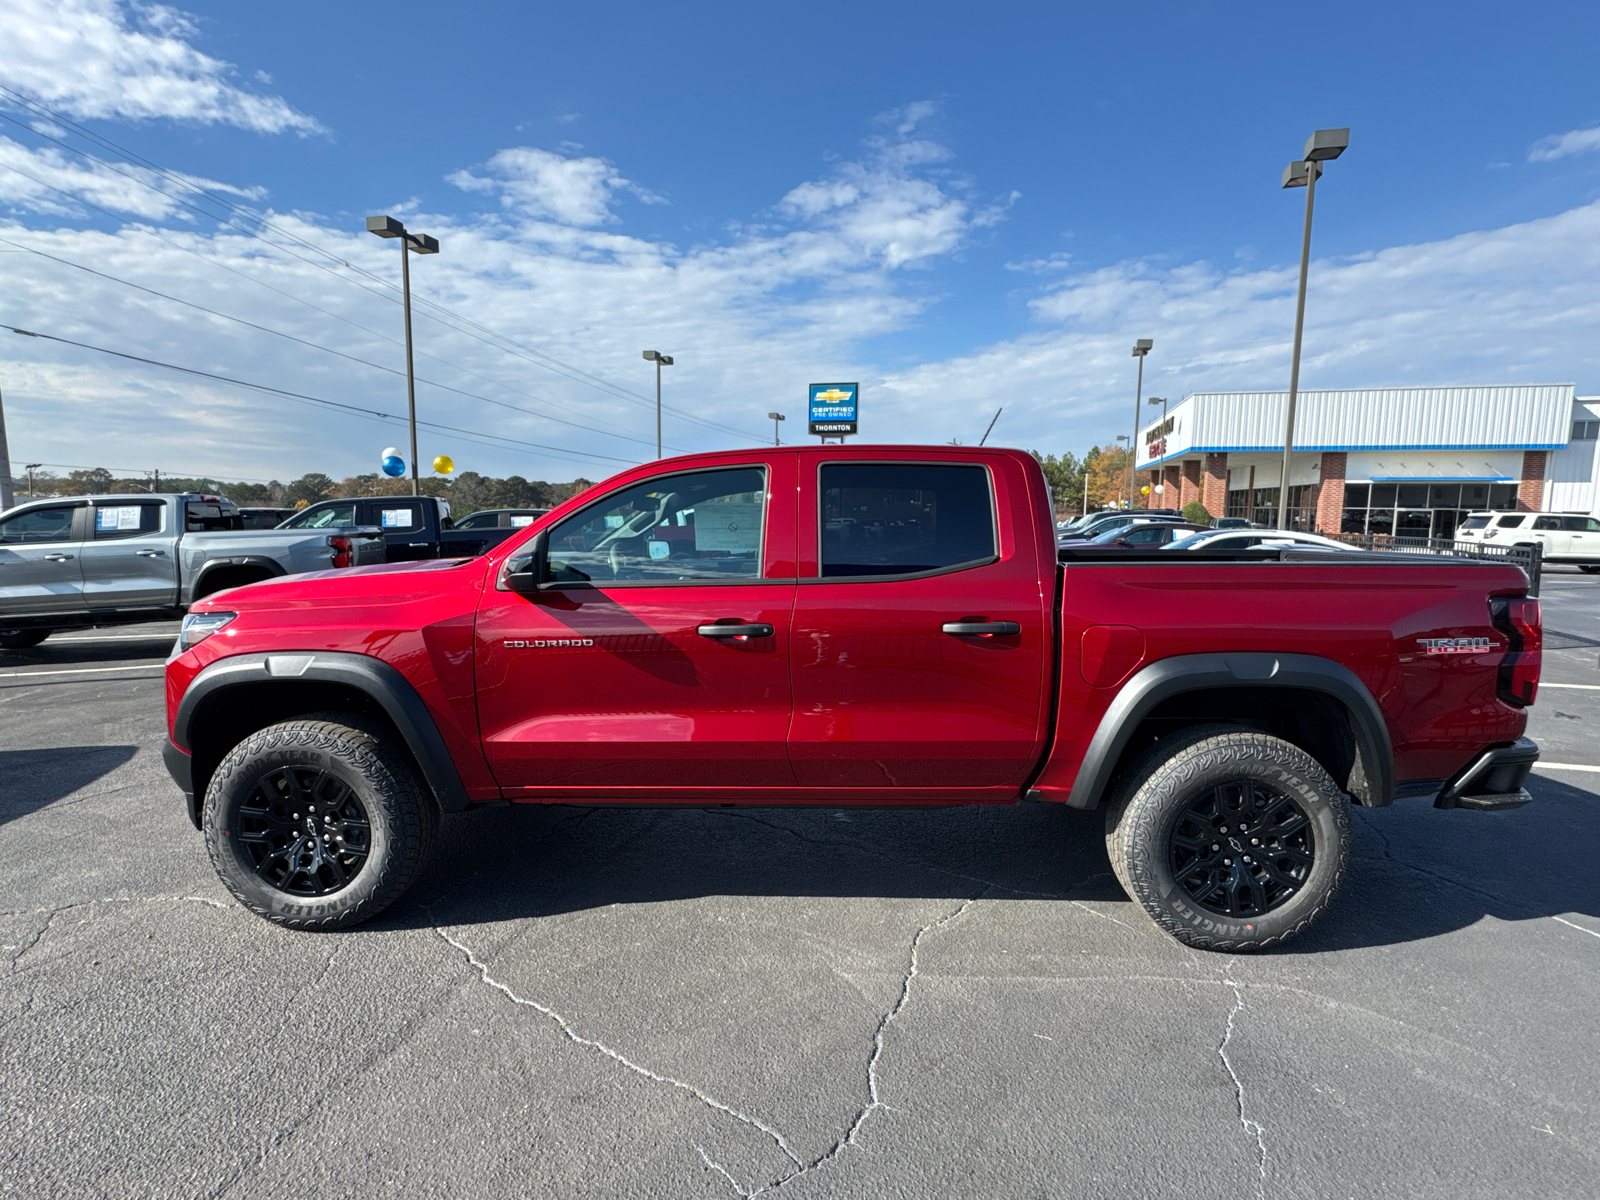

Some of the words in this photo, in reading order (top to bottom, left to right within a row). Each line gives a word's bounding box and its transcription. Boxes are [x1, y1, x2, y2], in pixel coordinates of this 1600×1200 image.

[503, 639, 594, 648] COLORADO
[1416, 637, 1500, 648] TRAIL
[1426, 646, 1489, 654] BOSS
